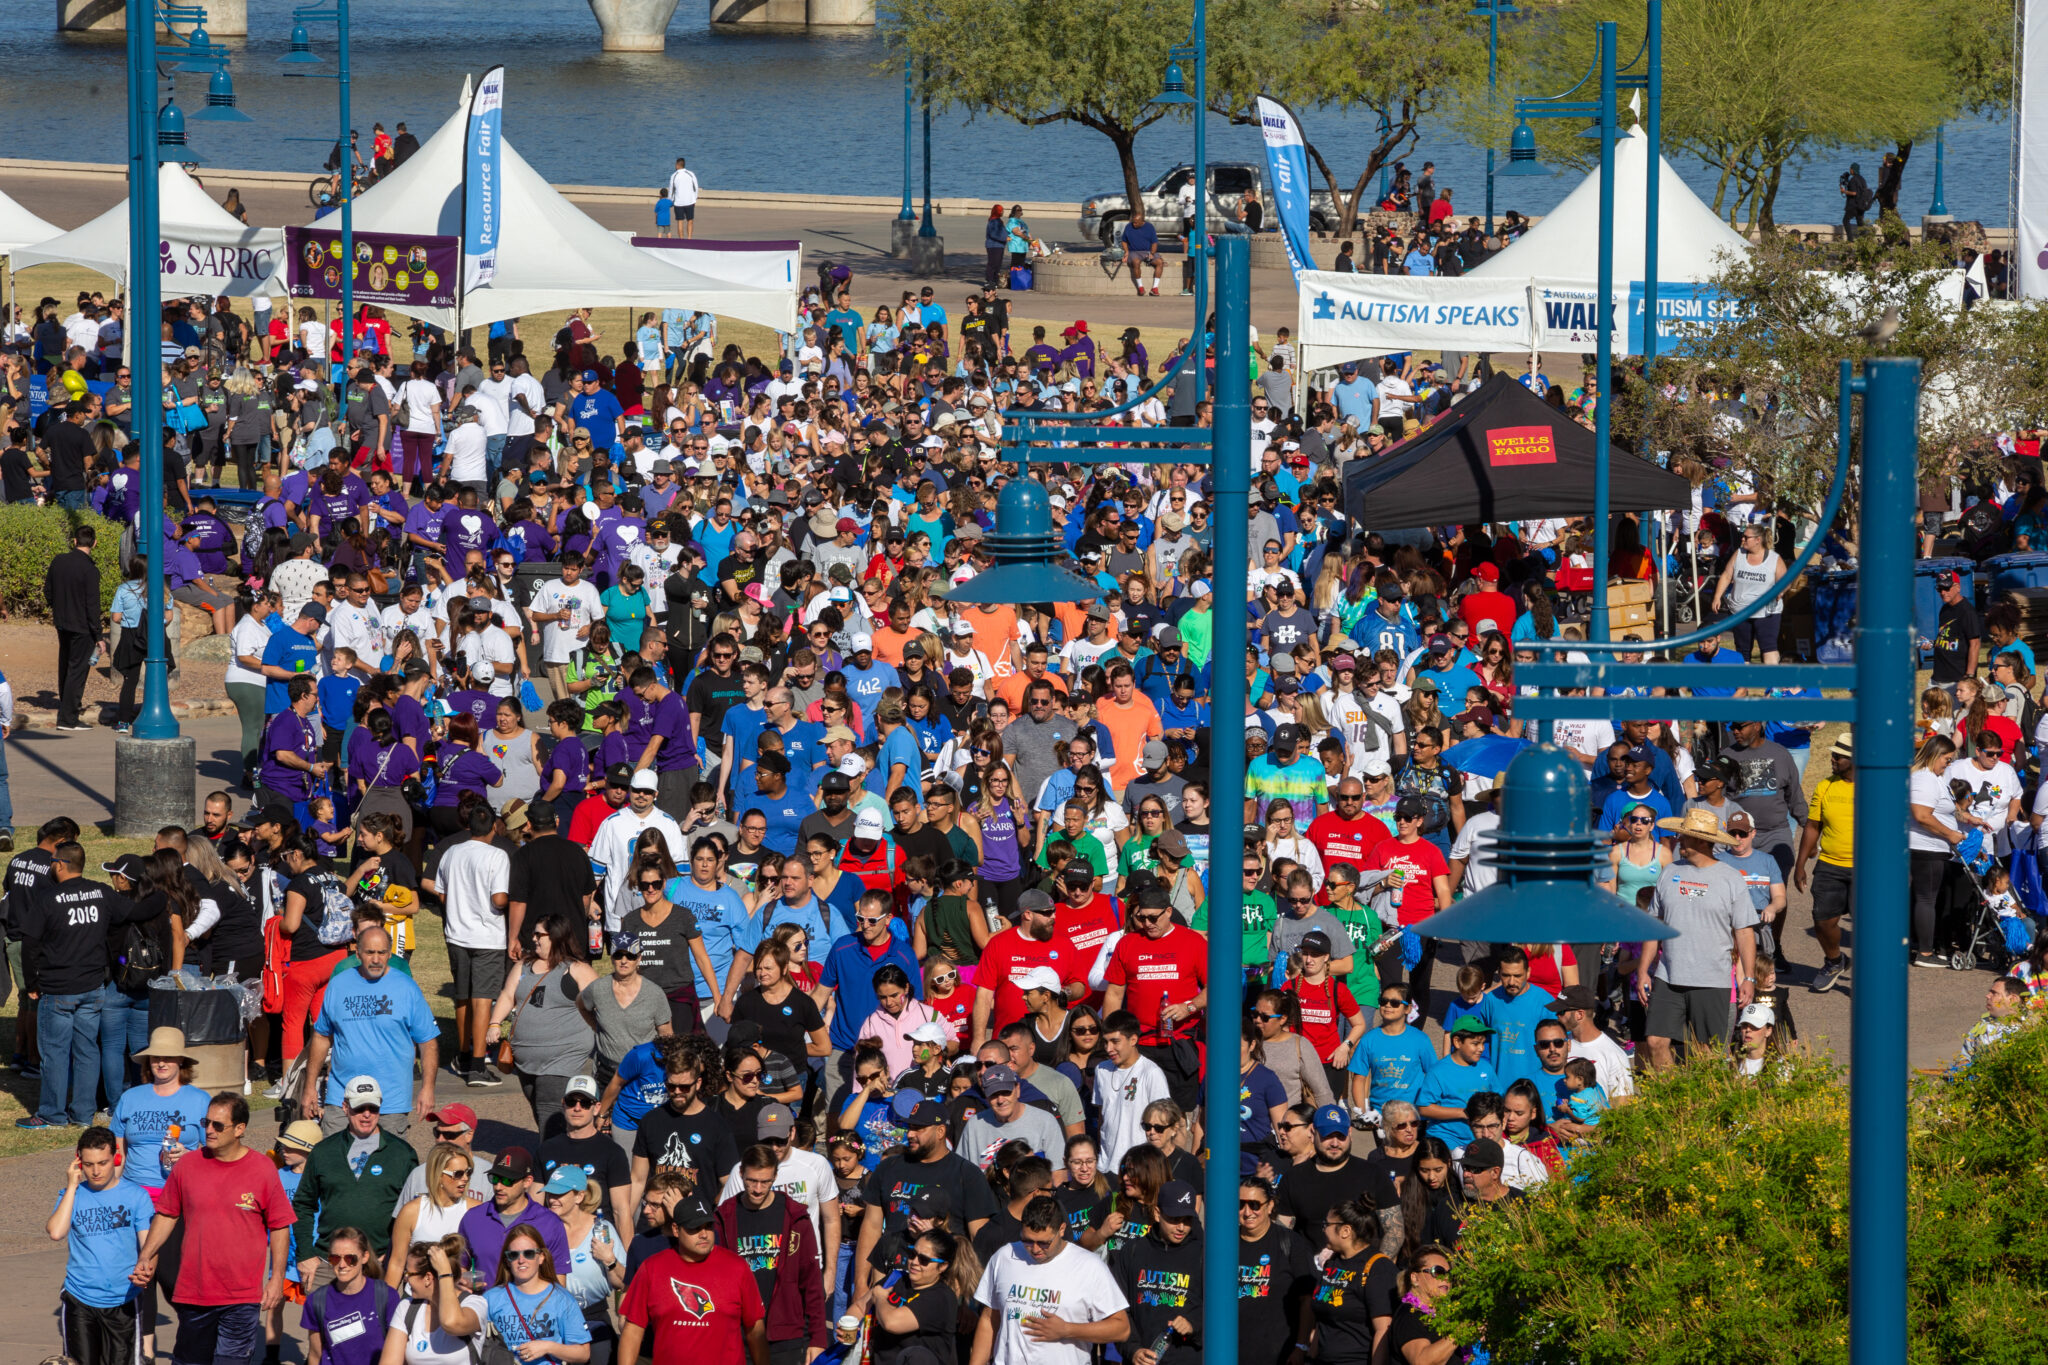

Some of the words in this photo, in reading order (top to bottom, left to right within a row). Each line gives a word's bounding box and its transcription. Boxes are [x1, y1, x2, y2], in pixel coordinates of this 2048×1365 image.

[1263, 116, 1286, 129] WALK
[478, 120, 492, 157] Fair
[480, 162, 492, 245] Resource
[185, 244, 272, 281] SARRC
[480, 259, 495, 270] WAL
[1553, 289, 1587, 300] AUTISM
[1588, 291, 1618, 300] SPS
[1340, 300, 1429, 324] AUTISM
[1435, 305, 1519, 327] SPEAKS
[1636, 298, 1702, 318] ATISM
[1584, 334, 1620, 344] SAC
[1491, 436, 1550, 447] WELLS
[1495, 445, 1550, 456] FARGO
[1380, 631, 1406, 660] 81
[857, 677, 882, 696] 412
[1346, 710, 1368, 724] SU
[14, 871, 35, 887] 2019
[55, 892, 79, 903] #Team
[67, 904, 99, 926] 2019
[344, 995, 377, 1004] AUTISM
[345, 1001, 377, 1011] SPEAKS
[352, 1008, 377, 1017] WALK
[132, 1110, 169, 1118] AUTISM
[132, 1117, 169, 1125] SPEAKS
[138, 1123, 169, 1131] WALK
[774, 1180, 807, 1195] TISM
[1177, 1191, 1191, 1204] A
[75, 1206, 113, 1218] AUTISM
[76, 1213, 114, 1227] SPEAKS
[85, 1223, 114, 1232] WALK
[1120, 1221, 1152, 1236] UTIS
[1239, 1264, 1271, 1279] TISM
[1138, 1268, 1190, 1289] AUTISM
[1008, 1283, 1062, 1305] AUTISM
